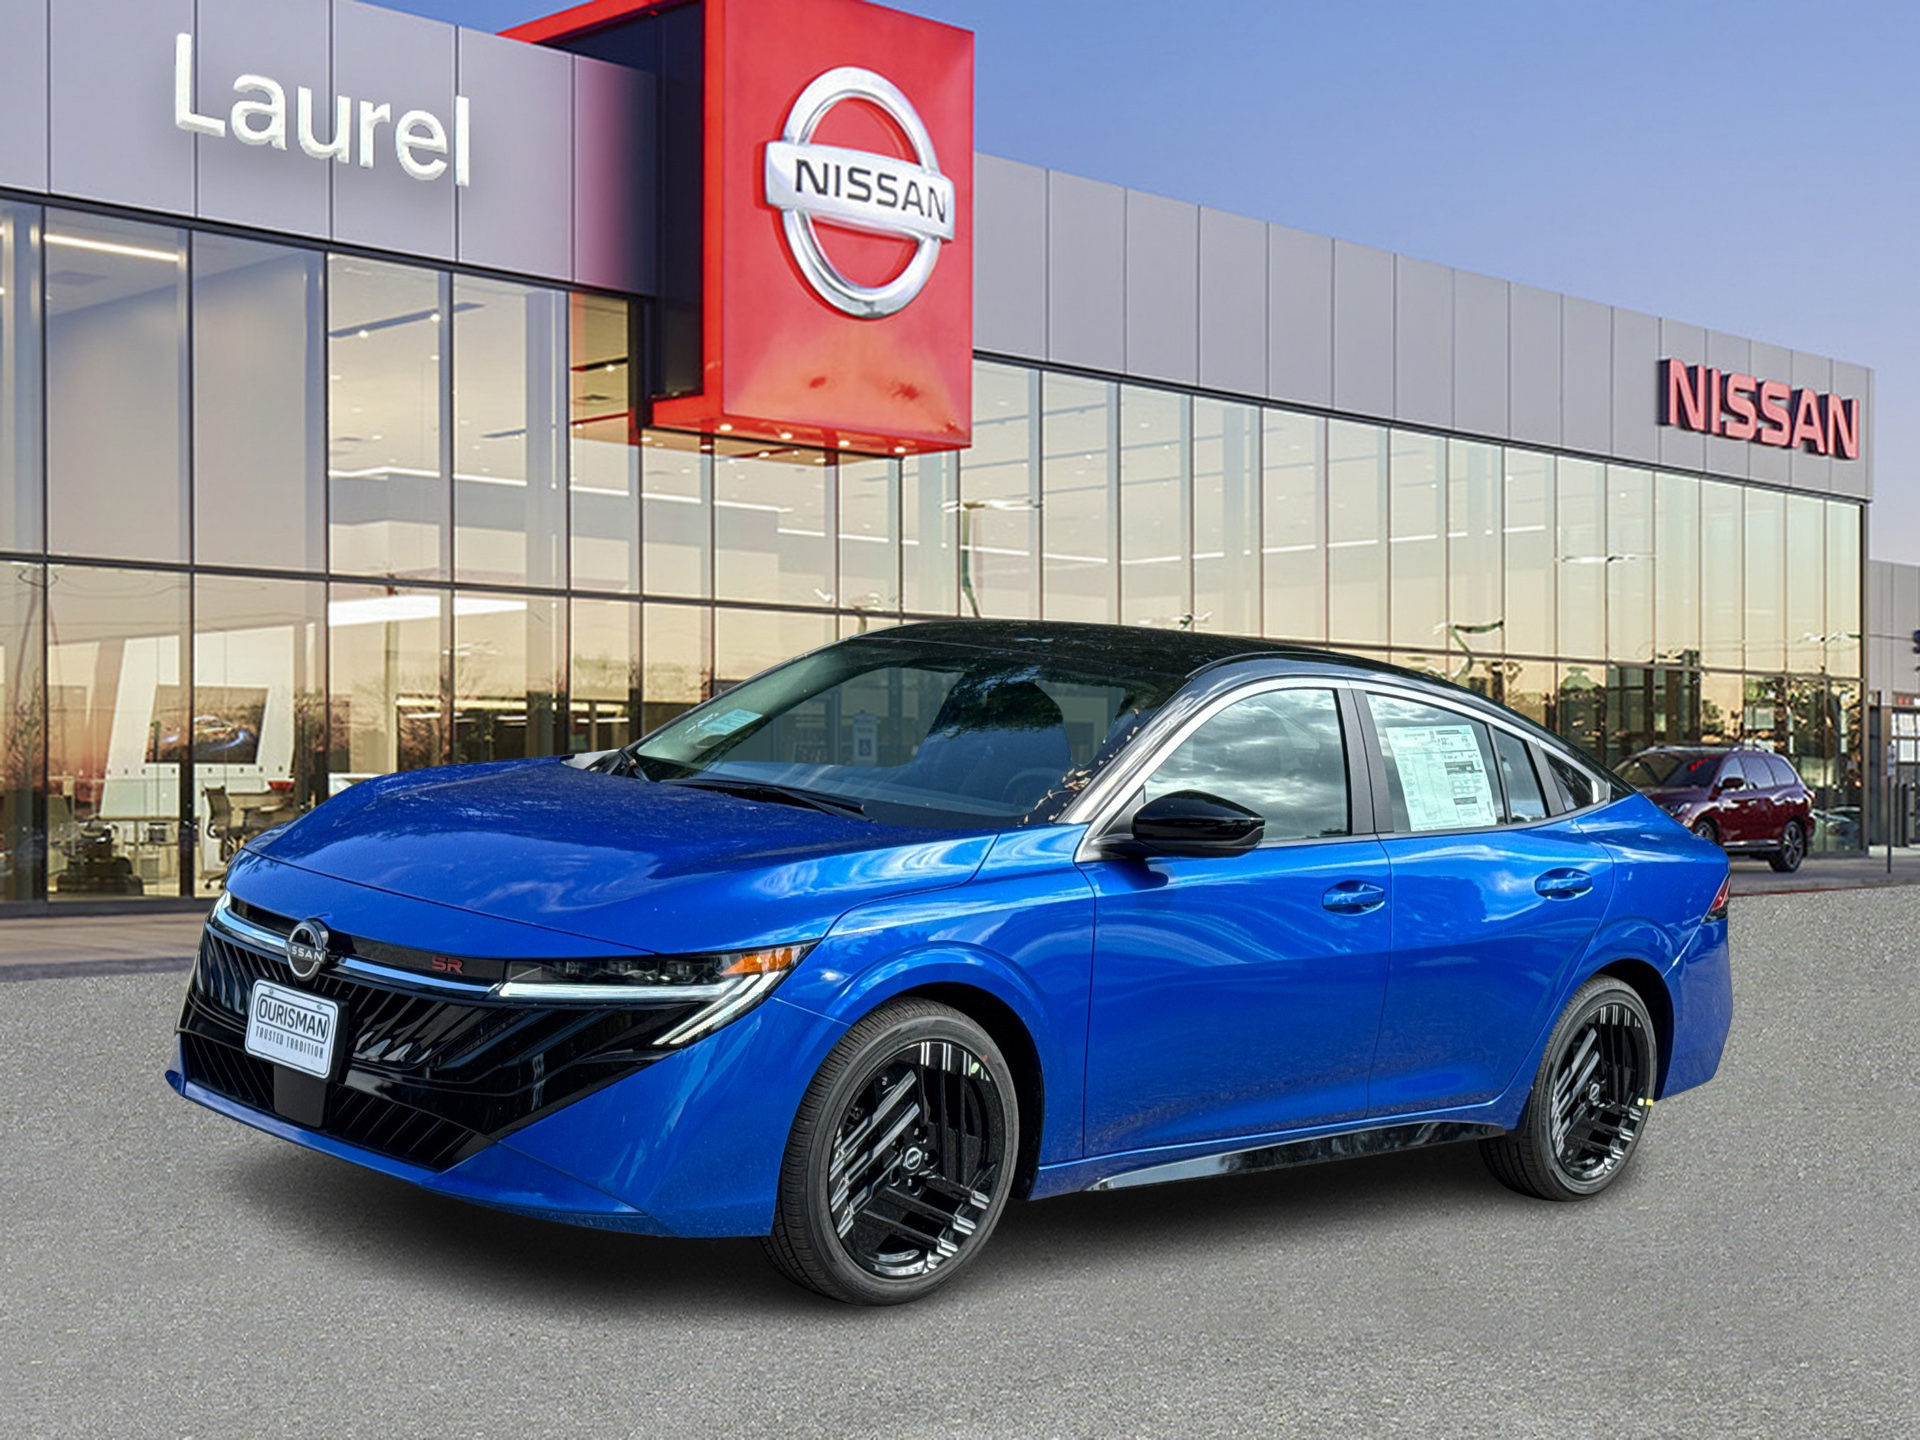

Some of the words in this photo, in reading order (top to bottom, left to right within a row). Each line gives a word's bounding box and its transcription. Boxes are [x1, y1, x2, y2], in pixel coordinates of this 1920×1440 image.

[175, 32, 470, 188] Laurel
[795, 158, 946, 224] NISSAN
[1658, 358, 1860, 460] NISSAN
[287, 942, 323, 961] SSAN
[432, 956, 463, 974] SR
[258, 998, 327, 1039] OURISMAN
[256, 1025, 284, 1046] TRUSTED
[286, 1036, 324, 1059] TRADITION
